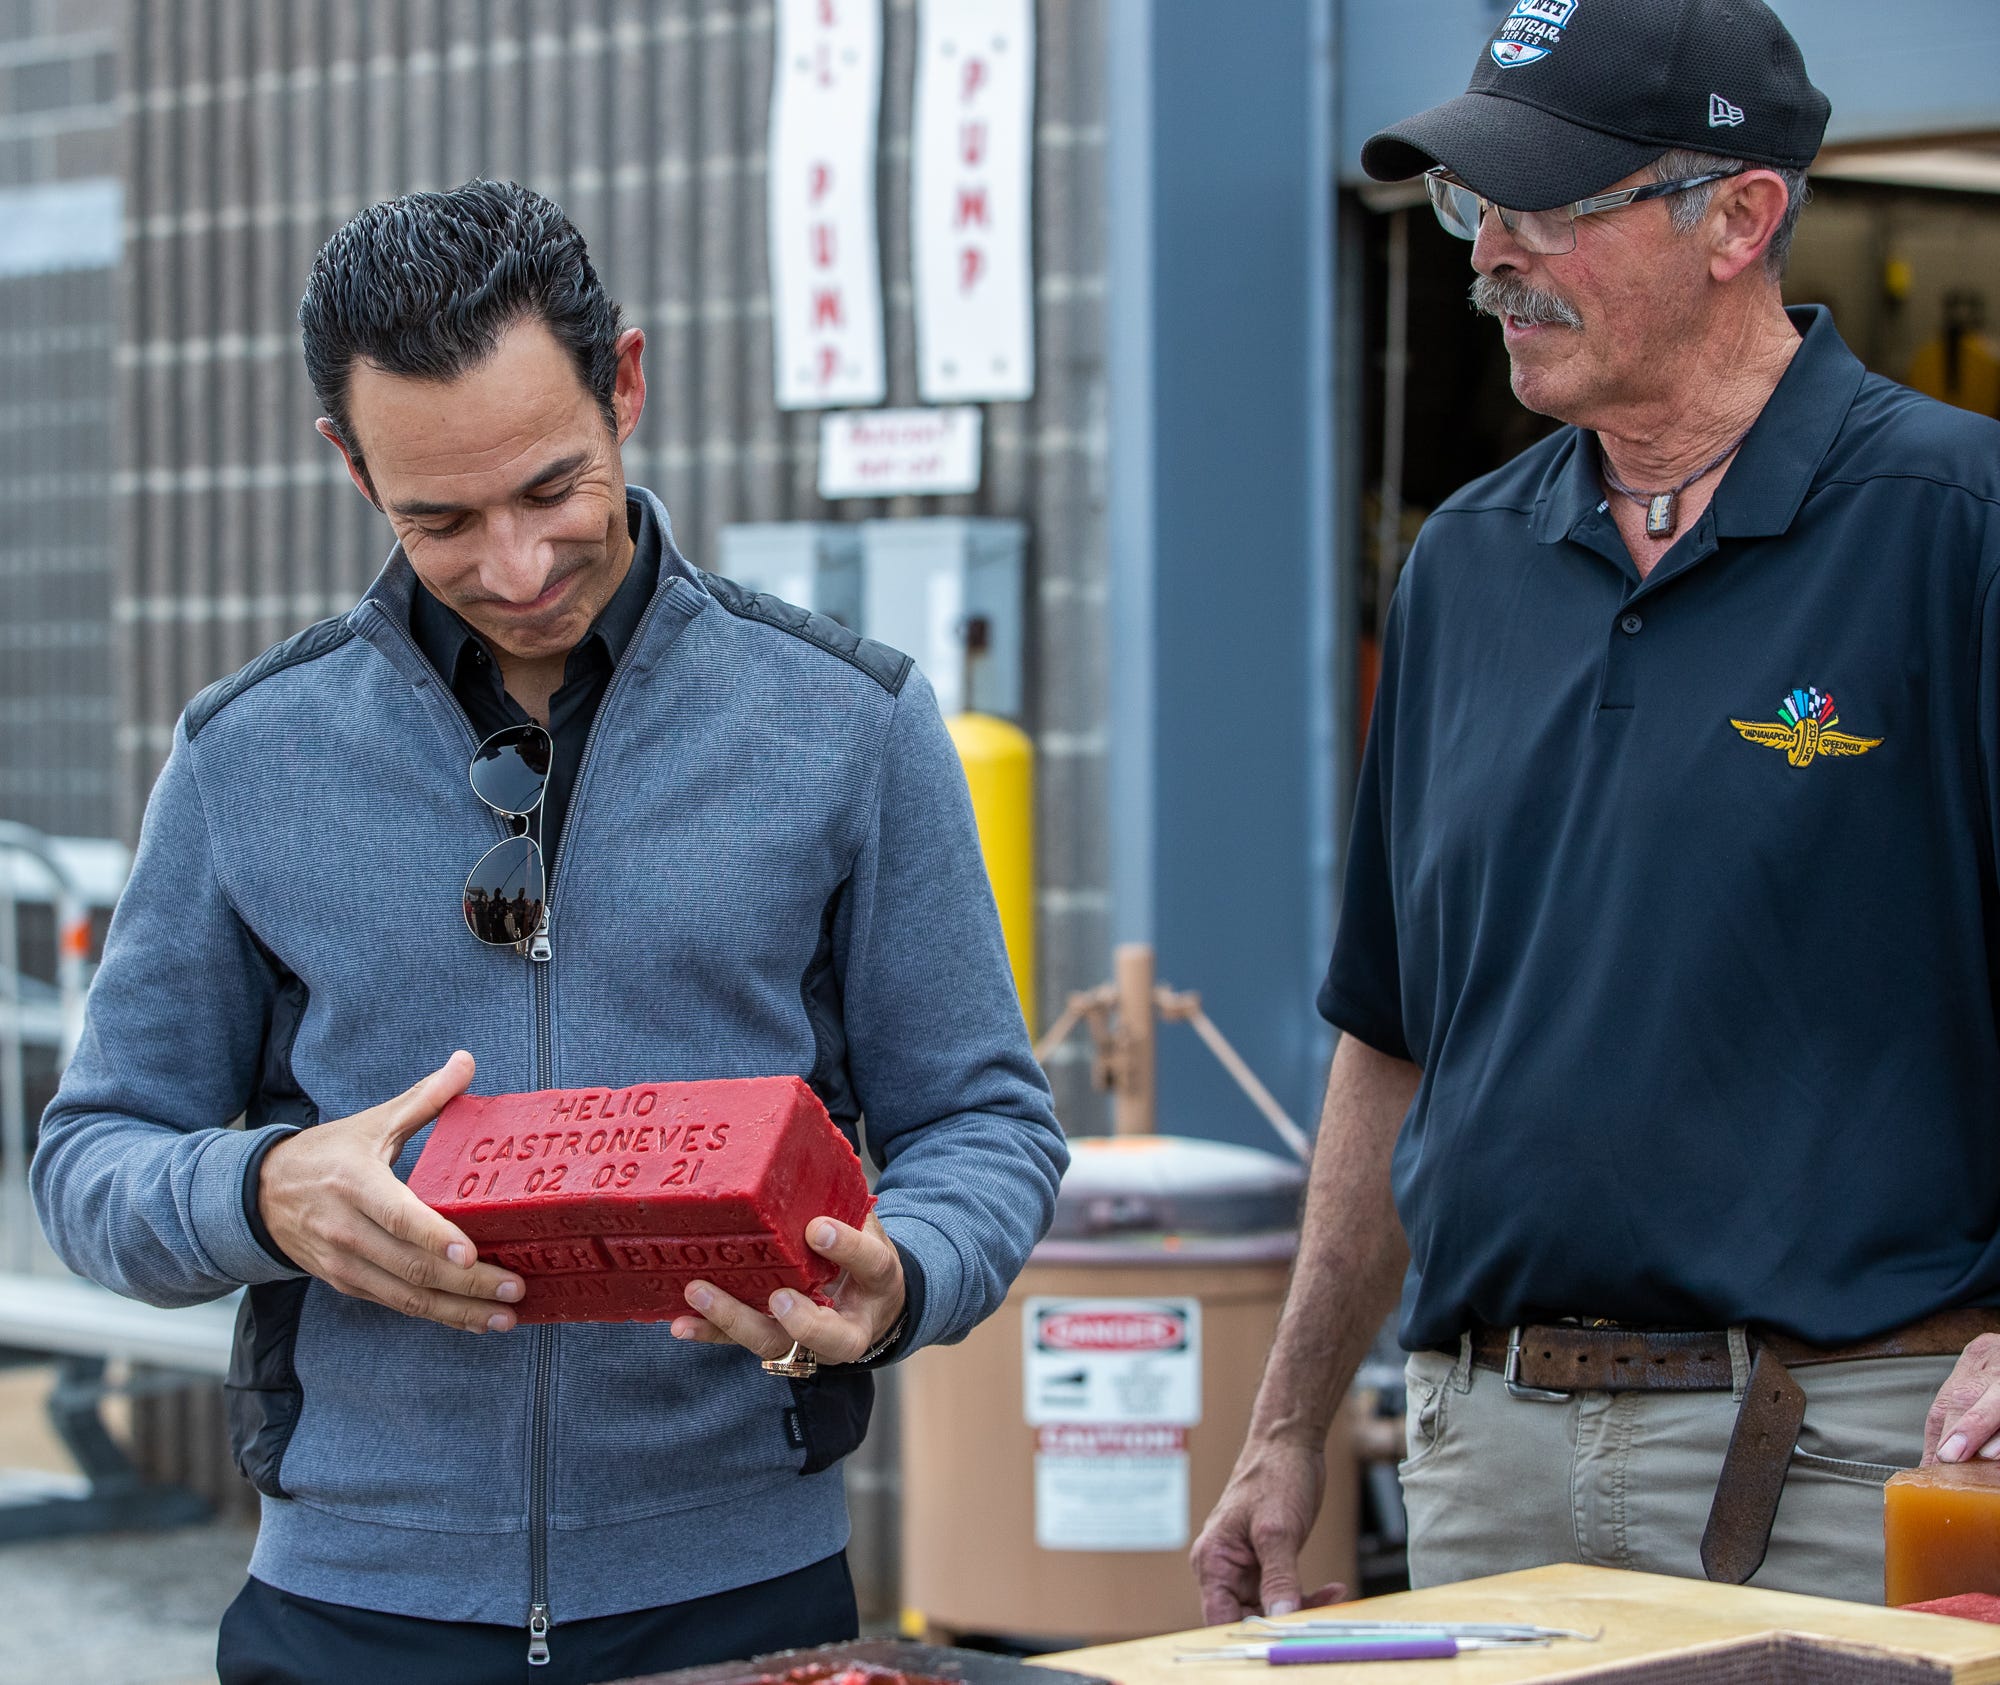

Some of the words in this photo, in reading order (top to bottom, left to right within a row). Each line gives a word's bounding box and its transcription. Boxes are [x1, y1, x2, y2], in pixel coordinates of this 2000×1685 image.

[1531, 0, 1568, 17] NTT
[1501, 31, 1541, 45] SERIES
[952, 57, 993, 297] PUMP
[1744, 729, 1795, 742] INDIANAPOLIS
[1802, 723, 1817, 762] MOTOR
[1822, 738, 1861, 753] SPEEDWAY
[549, 1090, 658, 1124] HELIO
[469, 1123, 730, 1163] CASTRONEVES
[457, 1170, 500, 1199] 01
[523, 1162, 568, 1194] 02
[591, 1162, 640, 1189] 09
[659, 1158, 705, 1188] 21
[484, 1244, 597, 1273] VER
[616, 1241, 781, 1271] BLOCK
